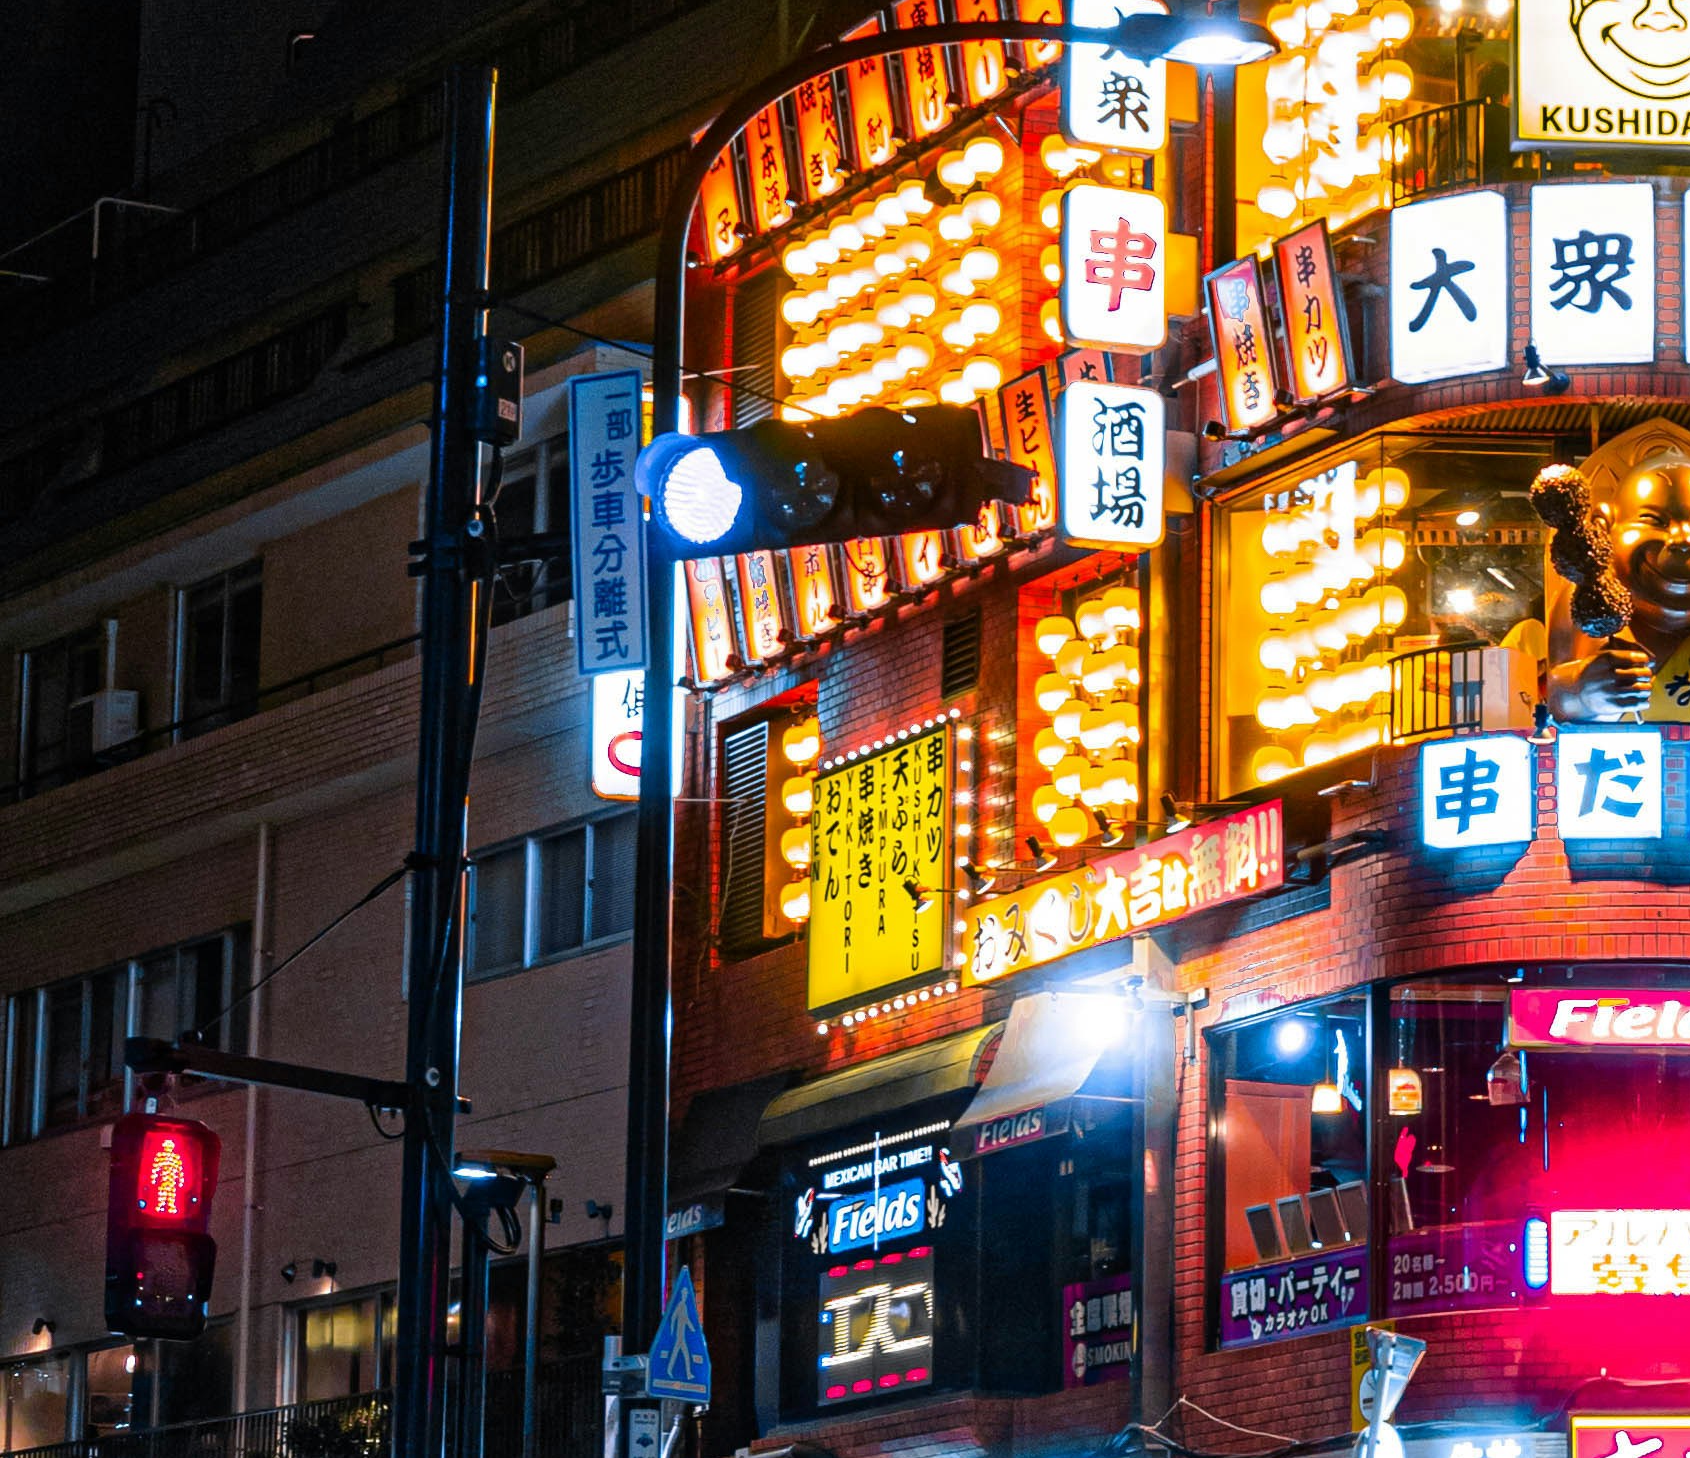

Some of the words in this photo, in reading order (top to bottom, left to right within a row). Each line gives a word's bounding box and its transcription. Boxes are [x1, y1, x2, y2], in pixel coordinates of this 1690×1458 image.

[1085, 217, 1156, 313] 串
[1090, 398, 1147, 530] 酒場
[824, 778, 841, 903] おでん
[857, 763, 875, 889] 串焼き
[877, 756, 888, 937] TEMPURA
[892, 747, 908, 876] 天ぷら
[912, 741, 922, 971] KUSHIKSU
[927, 736, 943, 864] 串カツ
[843, 769, 855, 974] YAKITORI
[823, 1161, 873, 1190] MEXICAN
[875, 1156, 898, 1177] BAR
[977, 1109, 1043, 1149] Fields
[666, 1203, 702, 1234] elds
[832, 1189, 922, 1245] Fields
[1087, 1340, 1132, 1367] SMOKIN
